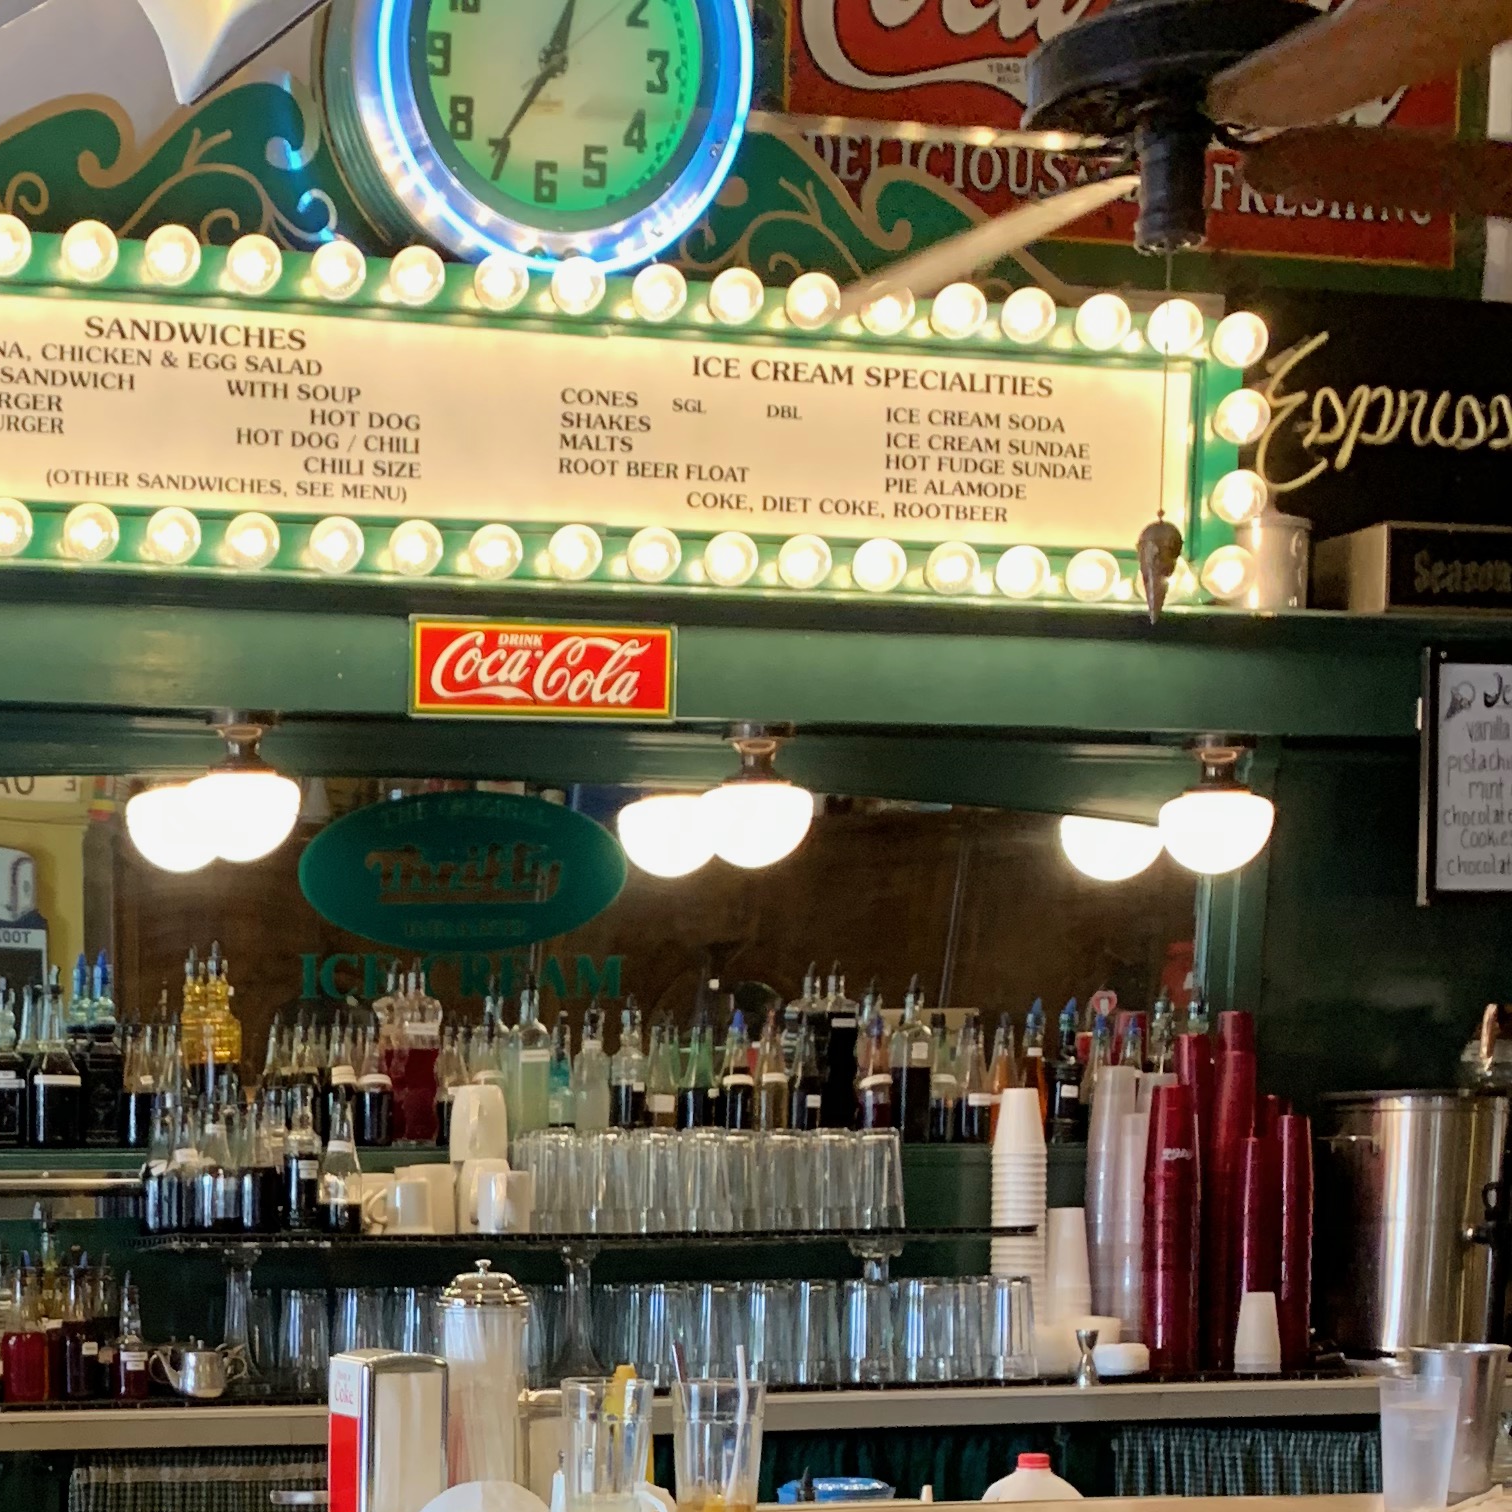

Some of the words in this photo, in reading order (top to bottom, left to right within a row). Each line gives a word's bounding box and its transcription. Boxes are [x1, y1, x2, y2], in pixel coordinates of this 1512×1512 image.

[428, 31, 452, 76] 9
[646, 49, 670, 94] 3
[449, 96, 474, 141] 8
[623, 109, 648, 154] 4
[488, 137, 511, 181] 7
[582, 145, 609, 189] 5
[534, 160, 559, 204] 6
[84, 315, 307, 351] SANDWICHES
[41, 343, 152, 367] CHICKEN
[161, 350, 179, 368] &
[188, 352, 237, 371] EGG
[244, 355, 323, 377] SALAD
[0, 366, 136, 391] SANDWICH
[227, 379, 289, 400] WITH
[296, 383, 361, 404] SOUP
[692, 355, 741, 379] ICE
[751, 359, 854, 386] CREAM
[864, 365, 1054, 399] SPECIALITIES
[310, 408, 360, 429] HOT
[368, 411, 421, 432] DOG
[560, 387, 639, 409] CONES
[672, 397, 707, 415] SGL
[766, 403, 803, 421] DBL
[885, 406, 921, 425] ICE
[928, 408, 1001, 430] CREAM
[1008, 414, 1066, 434] SODA
[560, 410, 652, 434] SHAKES
[236, 427, 284, 447] HOT
[291, 430, 339, 450] DOG
[346, 434, 357, 452] /
[364, 434, 420, 455] CHILI
[559, 432, 634, 454] MALTS
[885, 431, 921, 450] ICE
[928, 433, 1001, 455] CREAM
[1008, 438, 1090, 461] SUNDAE
[303, 456, 364, 477] CHILI
[372, 459, 422, 480] SIZE
[558, 456, 620, 477] ROOT
[626, 461, 679, 480] BEER
[686, 464, 750, 484] FLOAT
[885, 453, 931, 472] HOT
[937, 456, 1006, 476] FUDGE
[1011, 460, 1093, 482] SUNDAE
[46, 468, 129, 488] (OTHER
[136, 472, 288, 498] SANDWICHES,
[295, 480, 335, 498] SEE
[341, 483, 407, 504] MENU)
[884, 477, 918, 495] PIE
[924, 480, 1028, 500] ALAMODE
[686, 490, 755, 514] COKE,
[762, 494, 812, 514] DIET
[819, 498, 886, 519] COKE,
[893, 501, 1008, 523] ROOTBEER
[497, 632, 544, 649] DRINK
[430, 630, 652, 705] Coca-Cola
